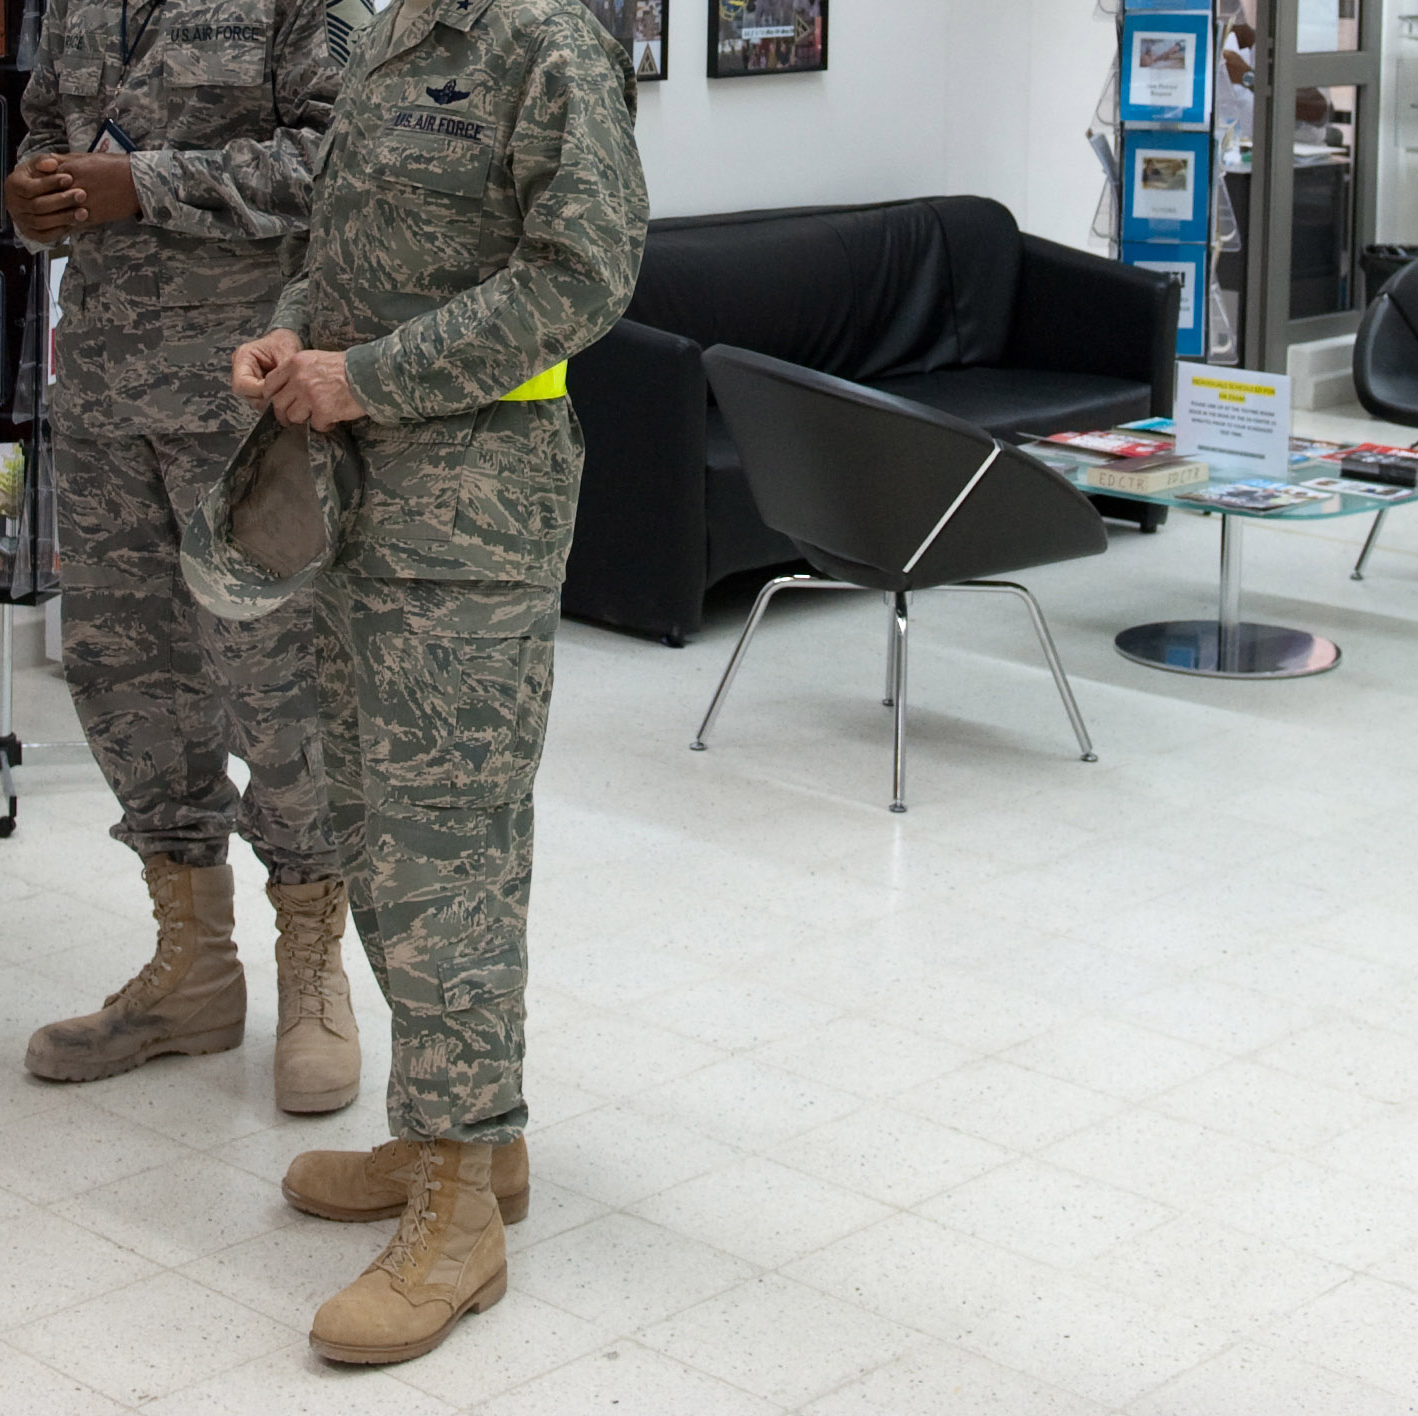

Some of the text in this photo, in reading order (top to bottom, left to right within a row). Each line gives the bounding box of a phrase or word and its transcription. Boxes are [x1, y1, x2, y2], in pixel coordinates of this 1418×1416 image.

[194, 27, 213, 42] AIR
[215, 25, 260, 41] FORCE
[414, 114, 437, 132] AIR
[437, 118, 485, 141] FORCE
